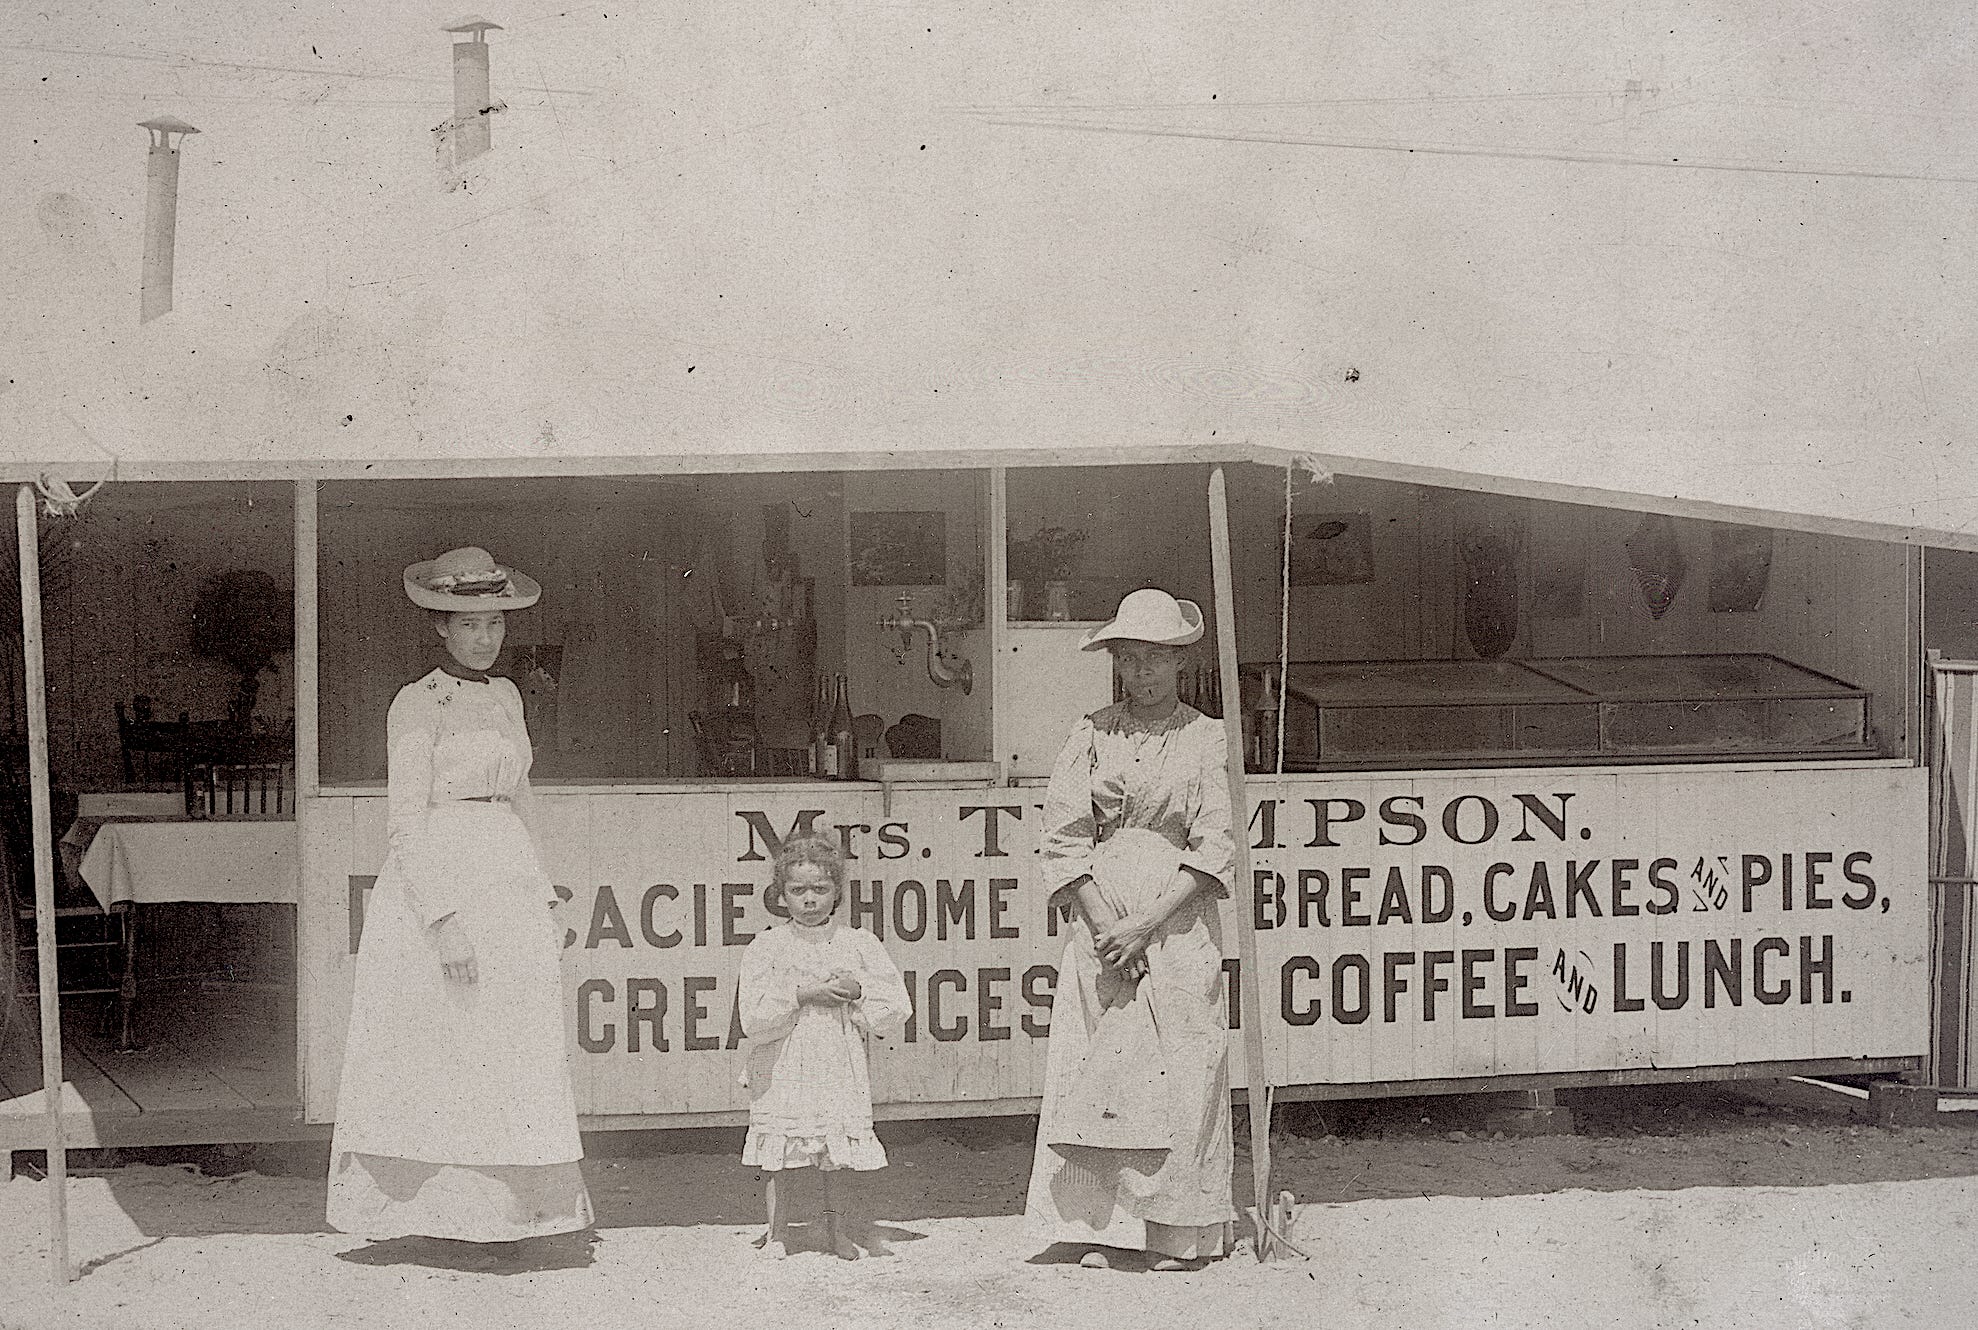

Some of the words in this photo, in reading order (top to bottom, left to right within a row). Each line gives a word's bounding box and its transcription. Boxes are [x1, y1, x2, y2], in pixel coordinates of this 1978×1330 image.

[735, 809, 932, 863] Mrs.
[959, 793, 1592, 859] TPSON.
[850, 878, 1020, 943] HOME
[1253, 864, 1472, 931] BREAD,
[1483, 857, 1680, 923] CAKES
[1690, 856, 1729, 912] AND
[1742, 851, 1891, 914] PIES,
[1280, 947, 1540, 1027] COFFEE
[1552, 947, 1599, 1016] AND
[1613, 934, 1853, 1012] LUNCH.
